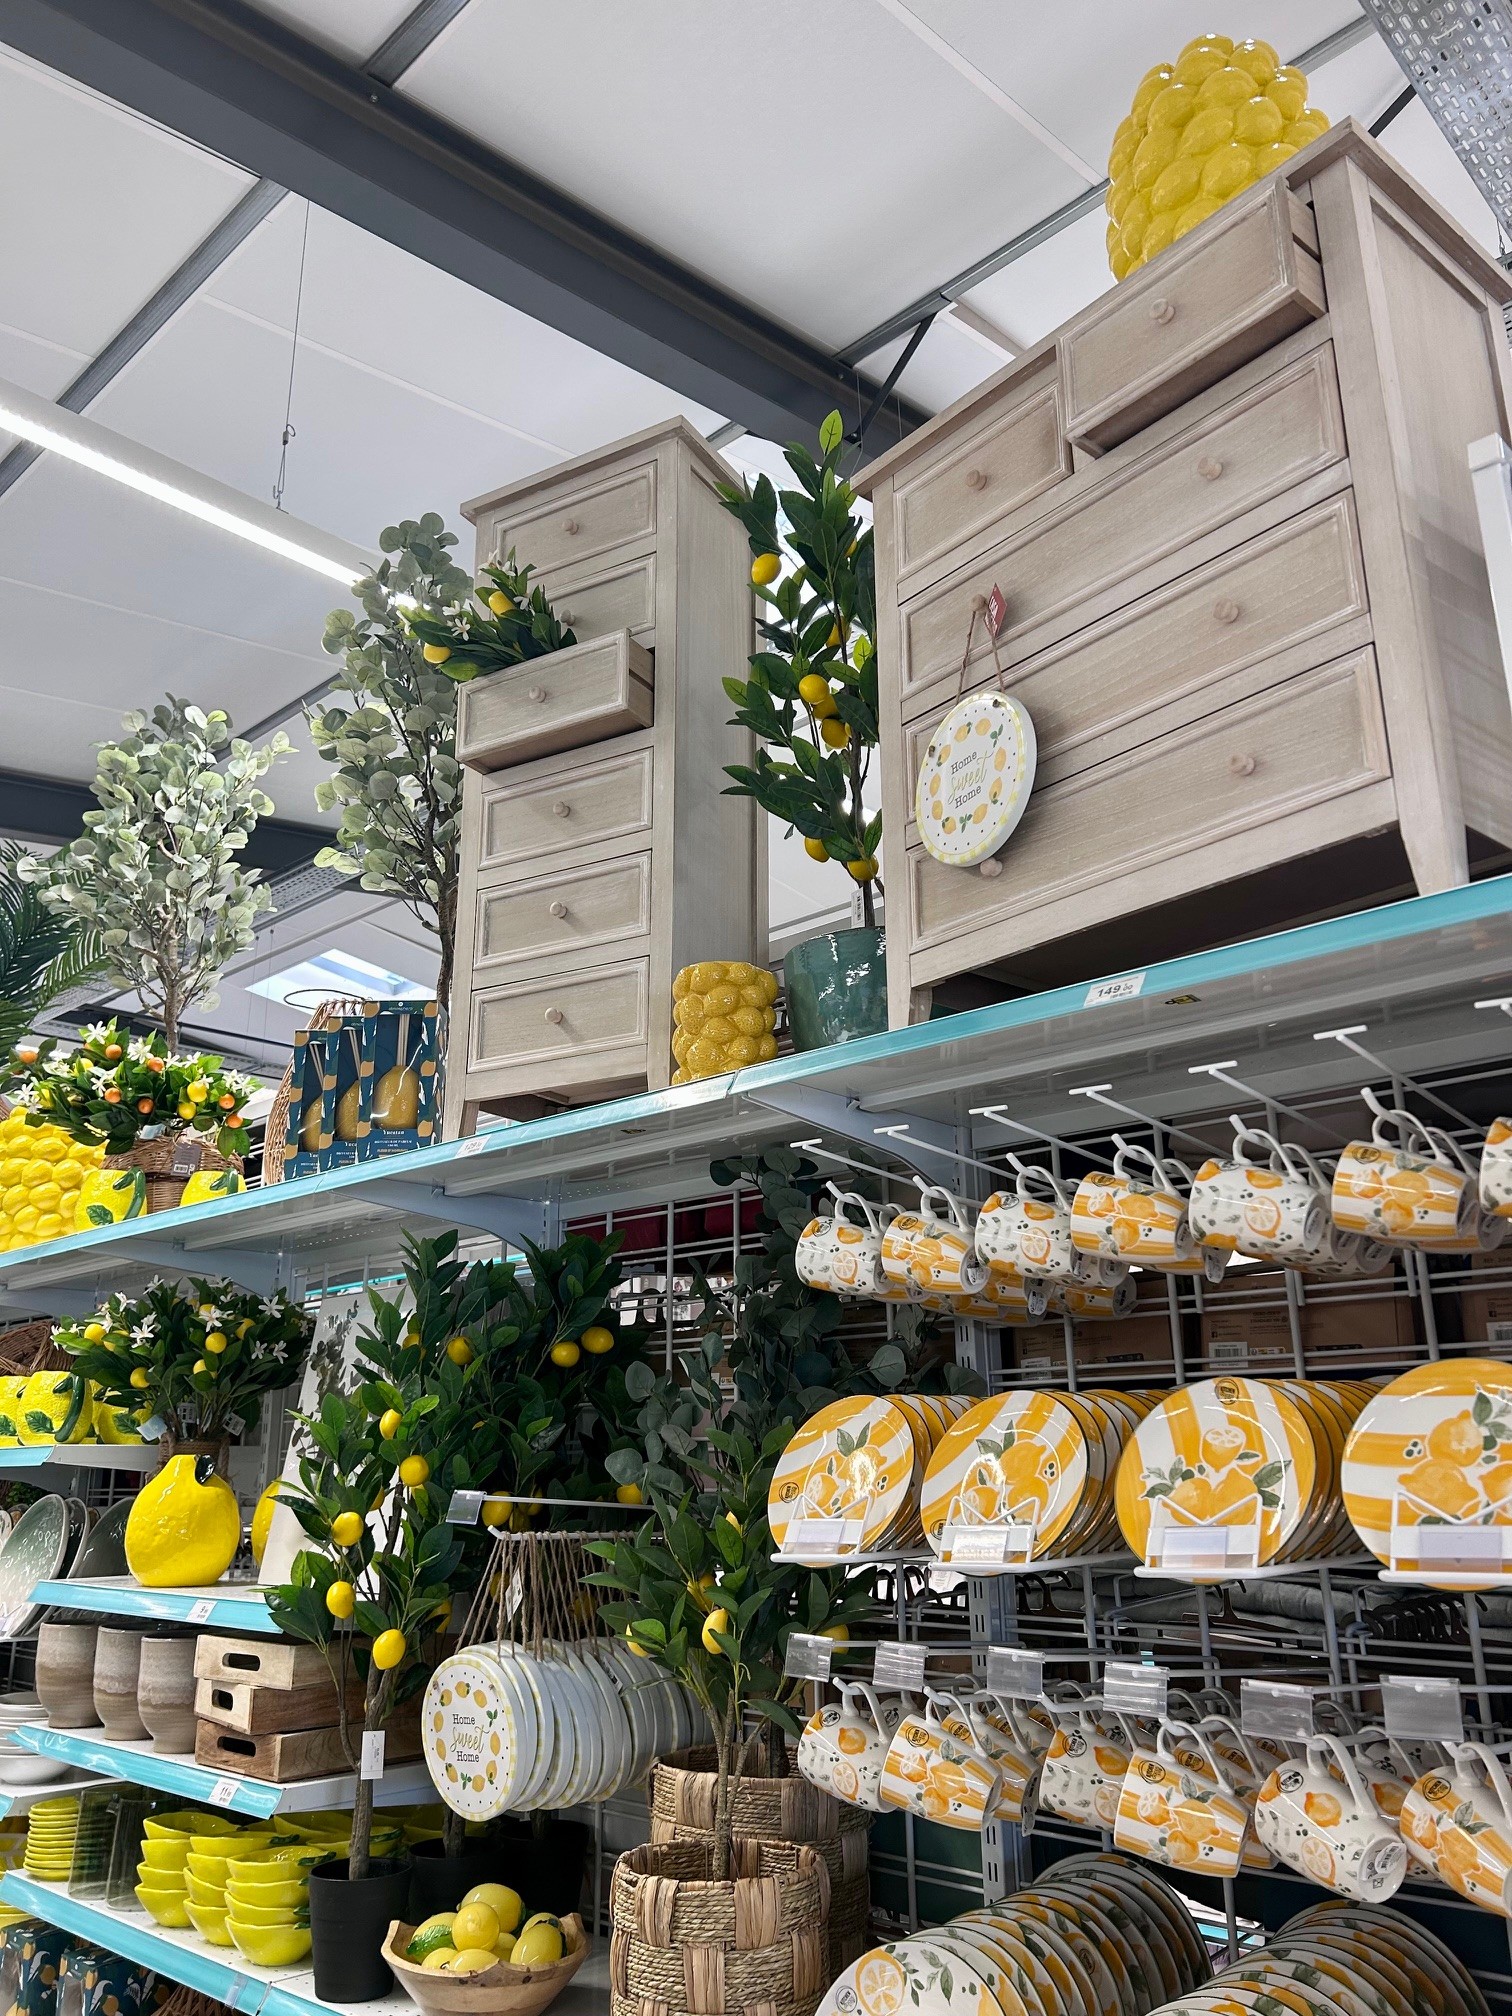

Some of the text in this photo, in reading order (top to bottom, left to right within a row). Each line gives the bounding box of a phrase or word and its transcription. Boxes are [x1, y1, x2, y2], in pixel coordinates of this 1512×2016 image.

[950, 751, 978, 775] Home
[954, 785, 982, 809] Home
[1098, 985, 1121, 997] 149
[452, 1713, 476, 1725] Home
[456, 1751, 479, 1763] Home
